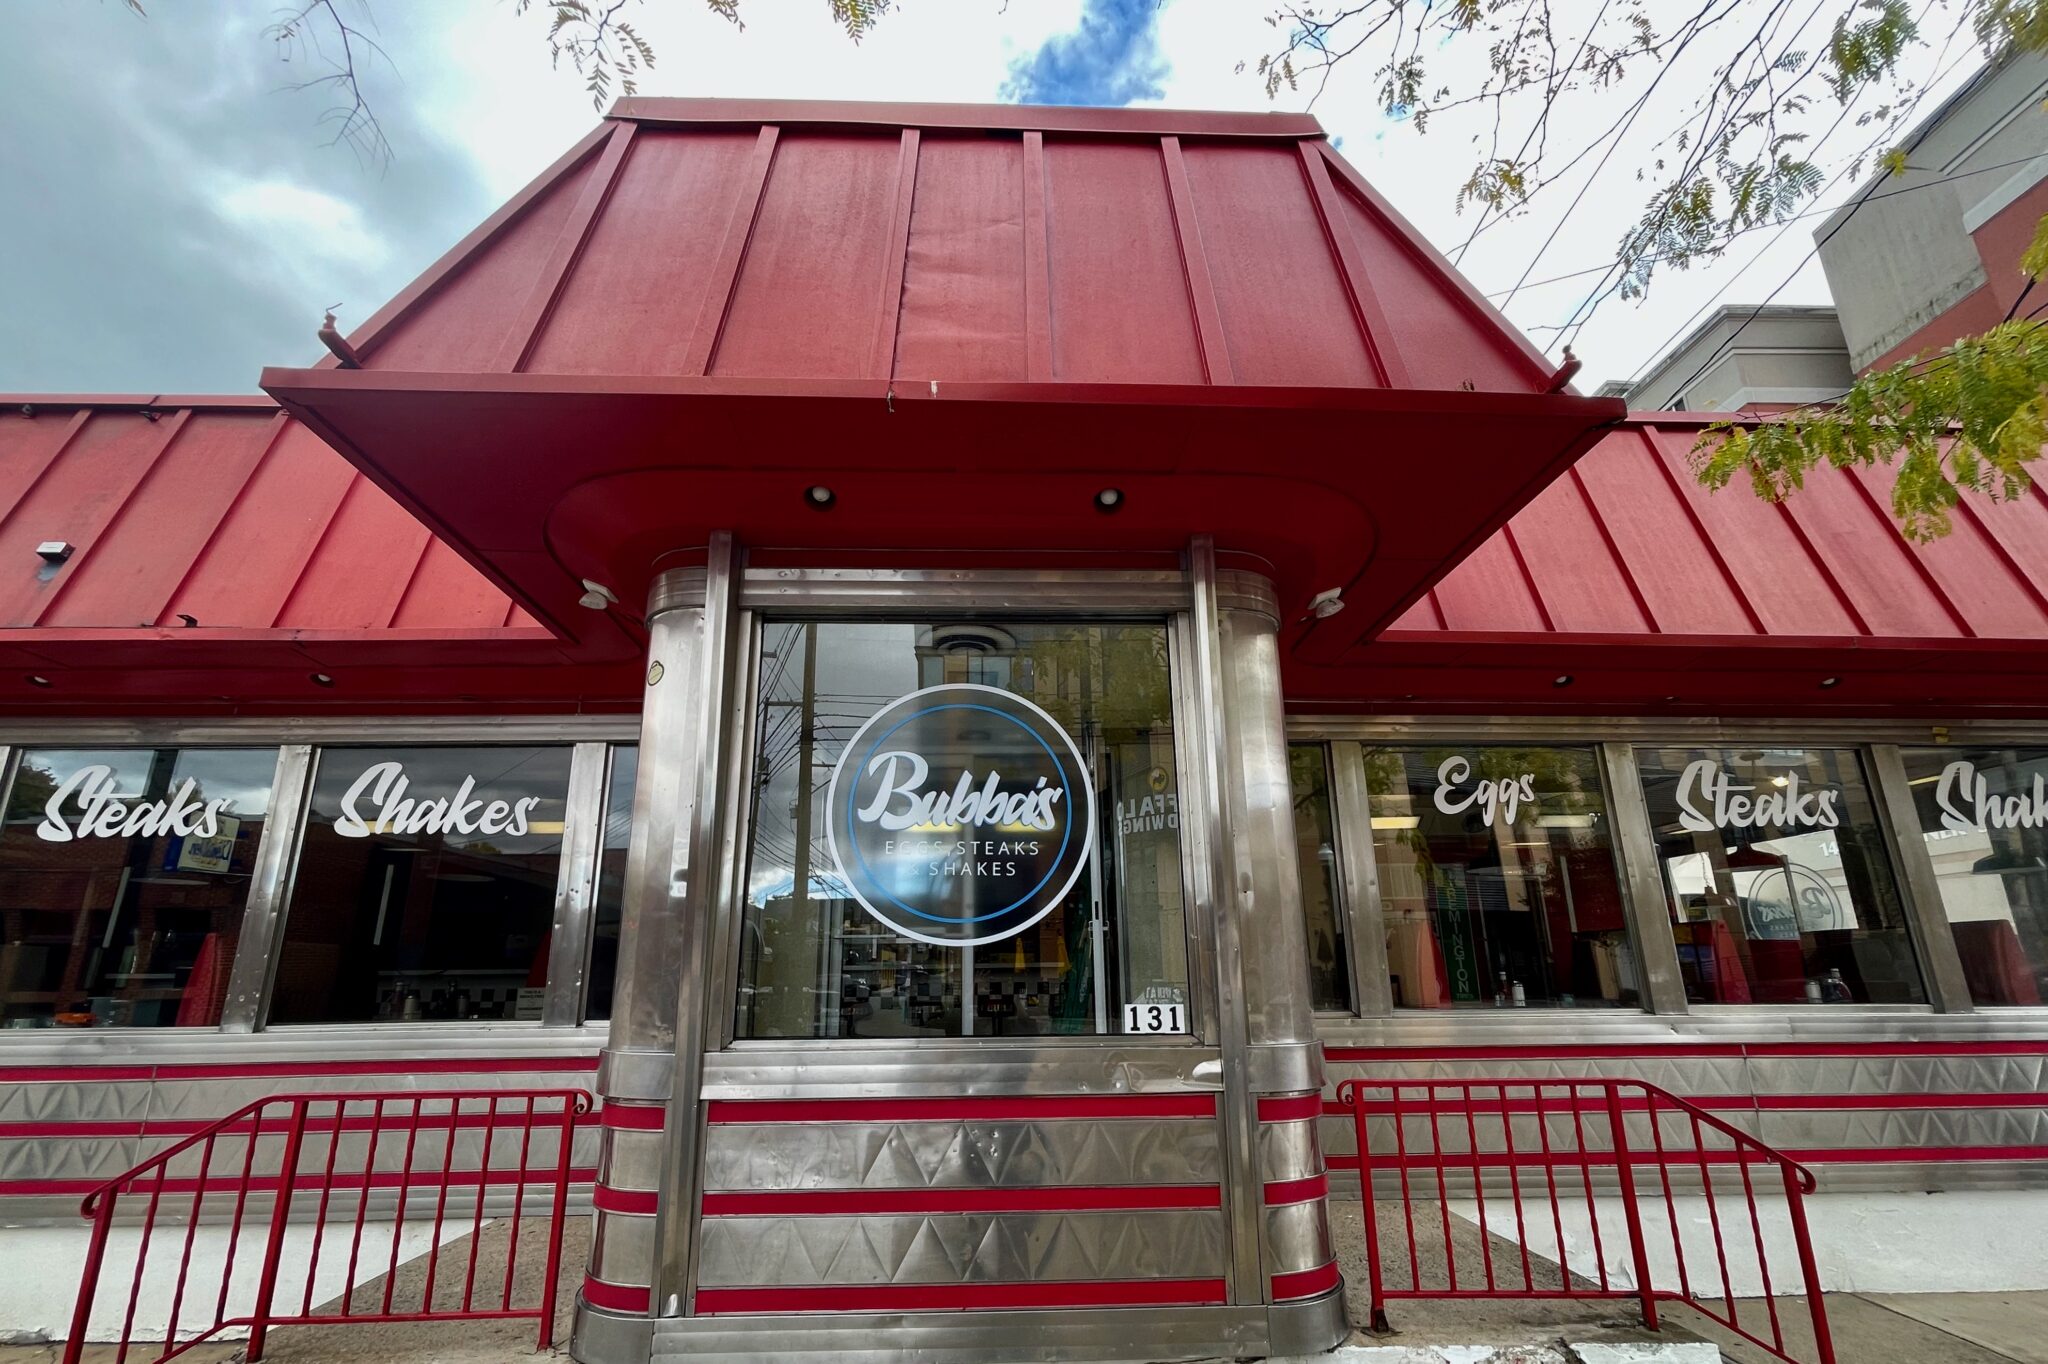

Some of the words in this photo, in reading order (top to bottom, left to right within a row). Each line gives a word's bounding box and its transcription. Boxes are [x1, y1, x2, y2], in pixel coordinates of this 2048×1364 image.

[36, 764, 232, 843] Steaks
[333, 761, 541, 838] Shakes
[858, 751, 1063, 830] Bubba's
[1433, 755, 1535, 827] Eggs
[1675, 759, 1840, 832] Steaks
[928, 861, 1017, 877] SHAKES
[956, 841, 1039, 856] STEAKS
[1129, 1005, 1181, 1032] 131
